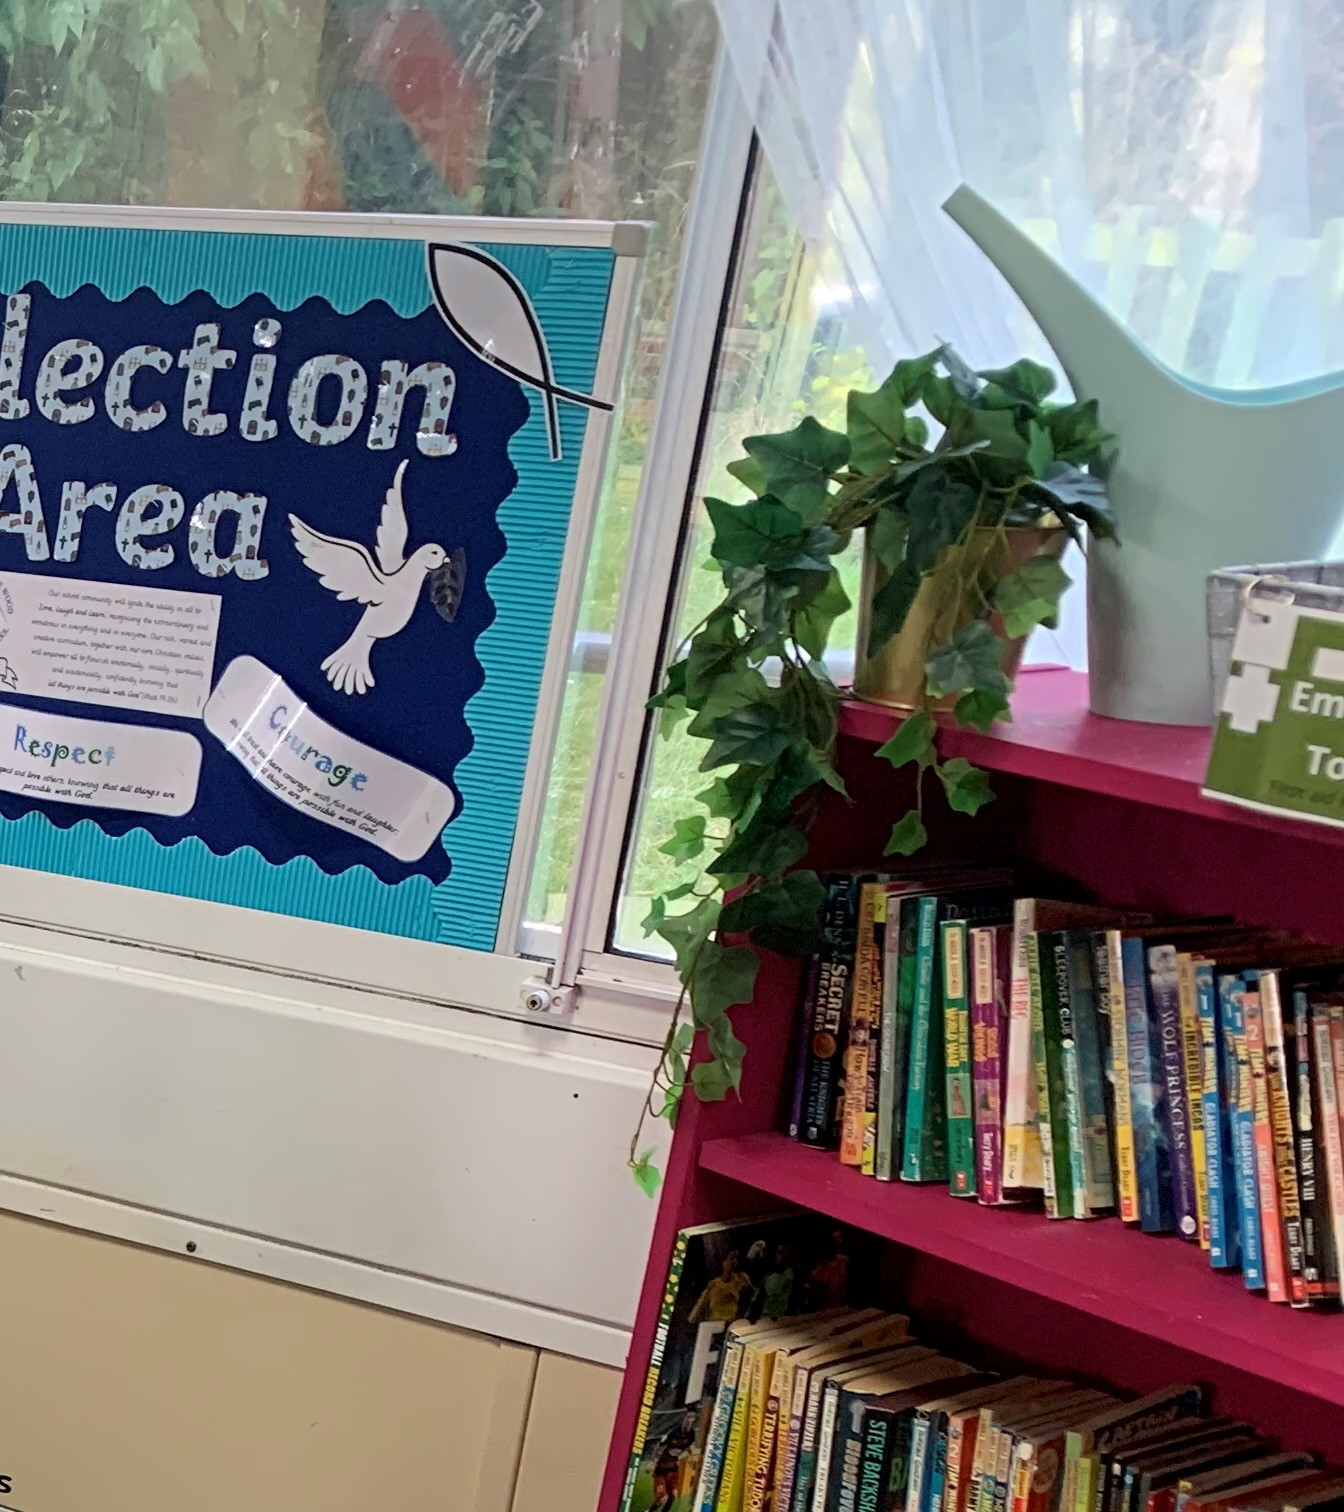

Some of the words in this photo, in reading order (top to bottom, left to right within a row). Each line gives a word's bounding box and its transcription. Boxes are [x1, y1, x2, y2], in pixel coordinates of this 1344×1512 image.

[2, 587, 14, 615] WOOD
[14, 723, 116, 768] Respect
[1307, 744, 1344, 780] To
[14, 768, 26, 778] and
[26, 770, 41, 781] love
[67, 777, 99, 792] knowing
[102, 781, 118, 792] that
[119, 784, 132, 793] all
[134, 785, 160, 798] things
[162, 790, 175, 799] are
[21, 781, 52, 793] possible
[55, 787, 72, 797] with
[267, 770, 287, 792] things
[287, 789, 301, 801] are
[301, 799, 336, 819] possible
[338, 814, 357, 827] with
[268, 755, 284, 773] have
[283, 770, 312, 794] courage
[313, 787, 332, 803] with
[331, 799, 346, 811] fun
[346, 804, 363, 818] and
[814, 962, 831, 1032] BREAKERS
[826, 964, 848, 1035] SECRET
[1062, 1007, 1072, 1036] CLUB
[1161, 1010, 1178, 1061] WOLF
[1168, 1065, 1187, 1150] PRINCESS
[1205, 1101, 1220, 1155] GLADIATOR
[1273, 1090, 1292, 1143] KNIGHTS
[1240, 1121, 1254, 1175] GLADIATOR
[1300, 1137, 1314, 1176] HENRY
[1208, 1158, 1220, 1188] CLASH
[1244, 1178, 1256, 1209] CLASH
[1281, 1165, 1299, 1217] CASTLES
[1303, 1179, 1315, 1200] VIII
[1286, 1221, 1299, 1245] TERRY
[1289, 1246, 1301, 1270] DEARY
[650, 1322, 671, 1367] FOOTBALL
[643, 1366, 660, 1405] RECORD
[633, 1404, 652, 1454] BREAKERS
[757, 1412, 777, 1473] TERRIFYING
[865, 1420, 887, 1460] STEVE
[719, 1437, 741, 1504] VICTORIANS
[782, 1432, 800, 1486] VILLAINOUS
